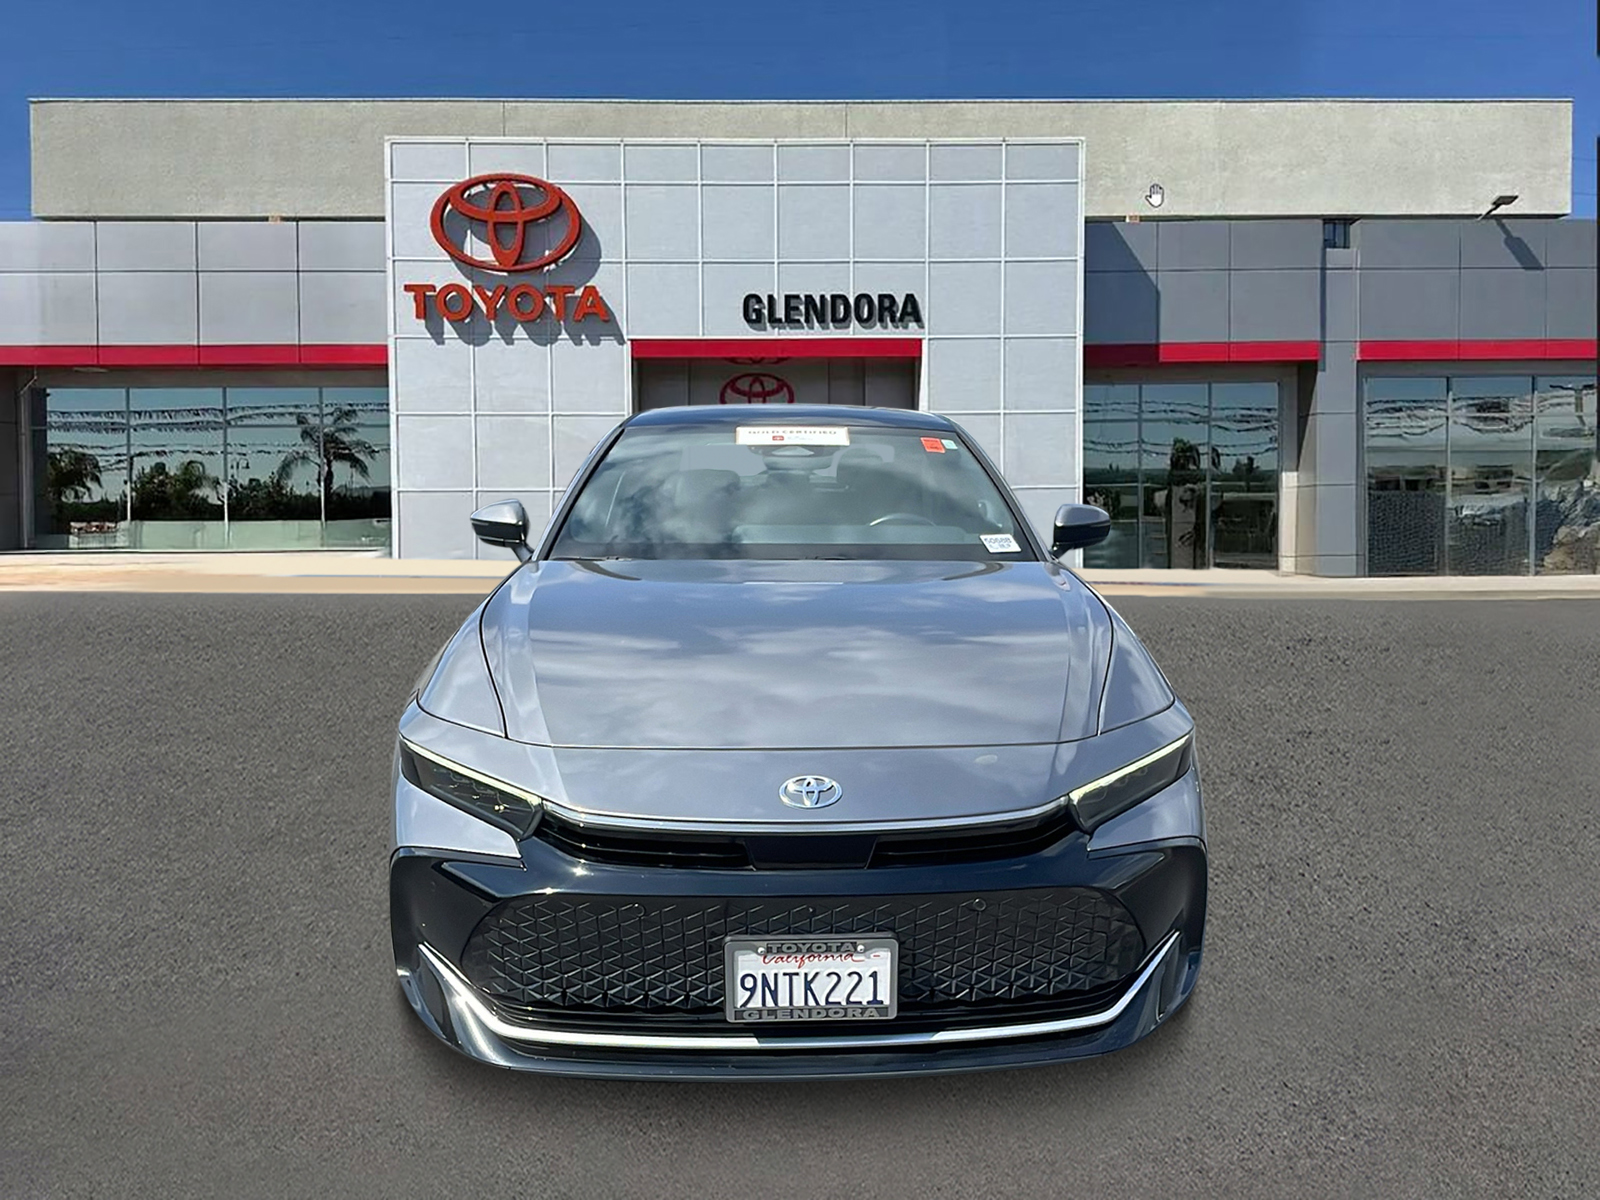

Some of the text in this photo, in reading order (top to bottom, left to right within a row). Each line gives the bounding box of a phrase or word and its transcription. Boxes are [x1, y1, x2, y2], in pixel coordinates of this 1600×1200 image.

[404, 283, 609, 322] TOYOTA
[743, 293, 922, 325] GLENDORA
[767, 942, 853, 953] TOYOTA
[762, 952, 864, 969] California
[739, 970, 884, 1009] 9NTK221
[742, 1007, 880, 1020] GLENDORA
